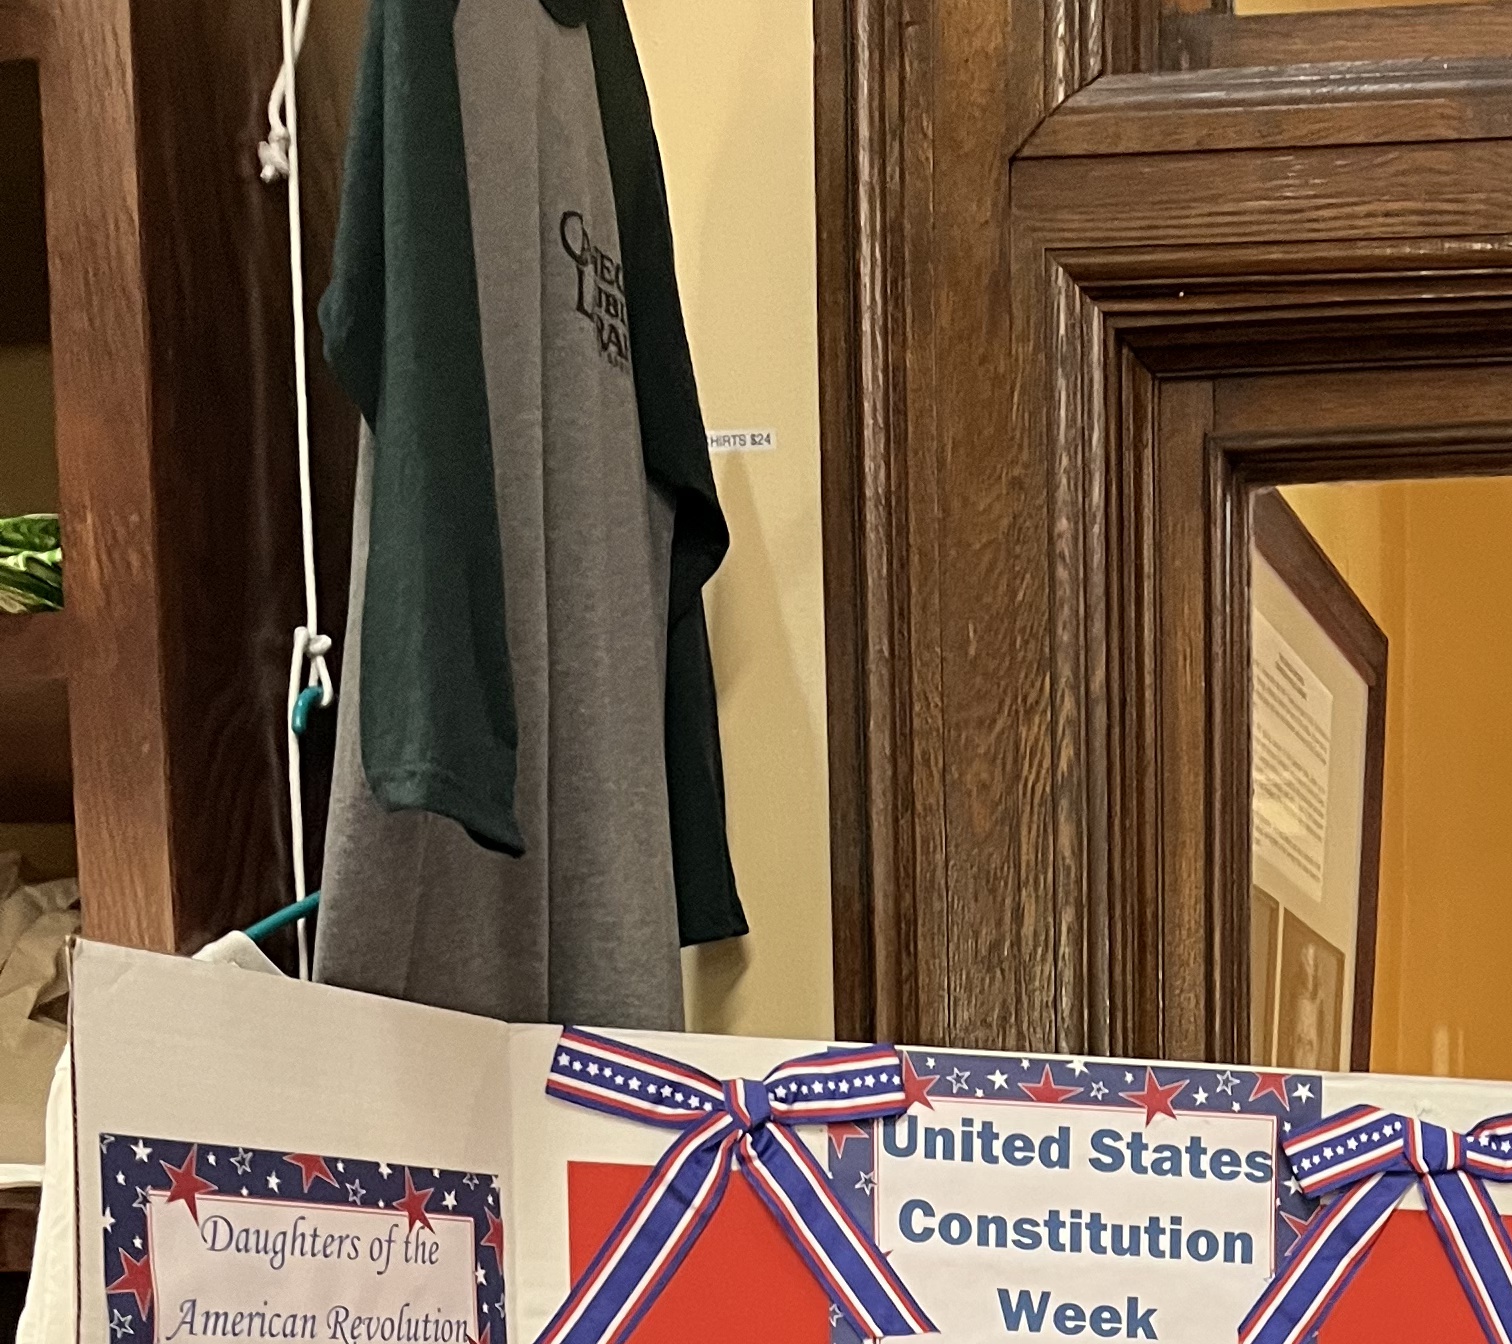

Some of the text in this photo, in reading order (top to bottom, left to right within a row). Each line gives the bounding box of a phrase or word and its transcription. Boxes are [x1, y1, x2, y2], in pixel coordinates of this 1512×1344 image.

[710, 434, 747, 447] HIRTS
[881, 1114, 1274, 1183] United States
[201, 1214, 440, 1275] Daughters of the
[898, 1199, 1255, 1265] Constitution
[165, 1298, 317, 1341] American
[997, 1288, 1158, 1341] Week
